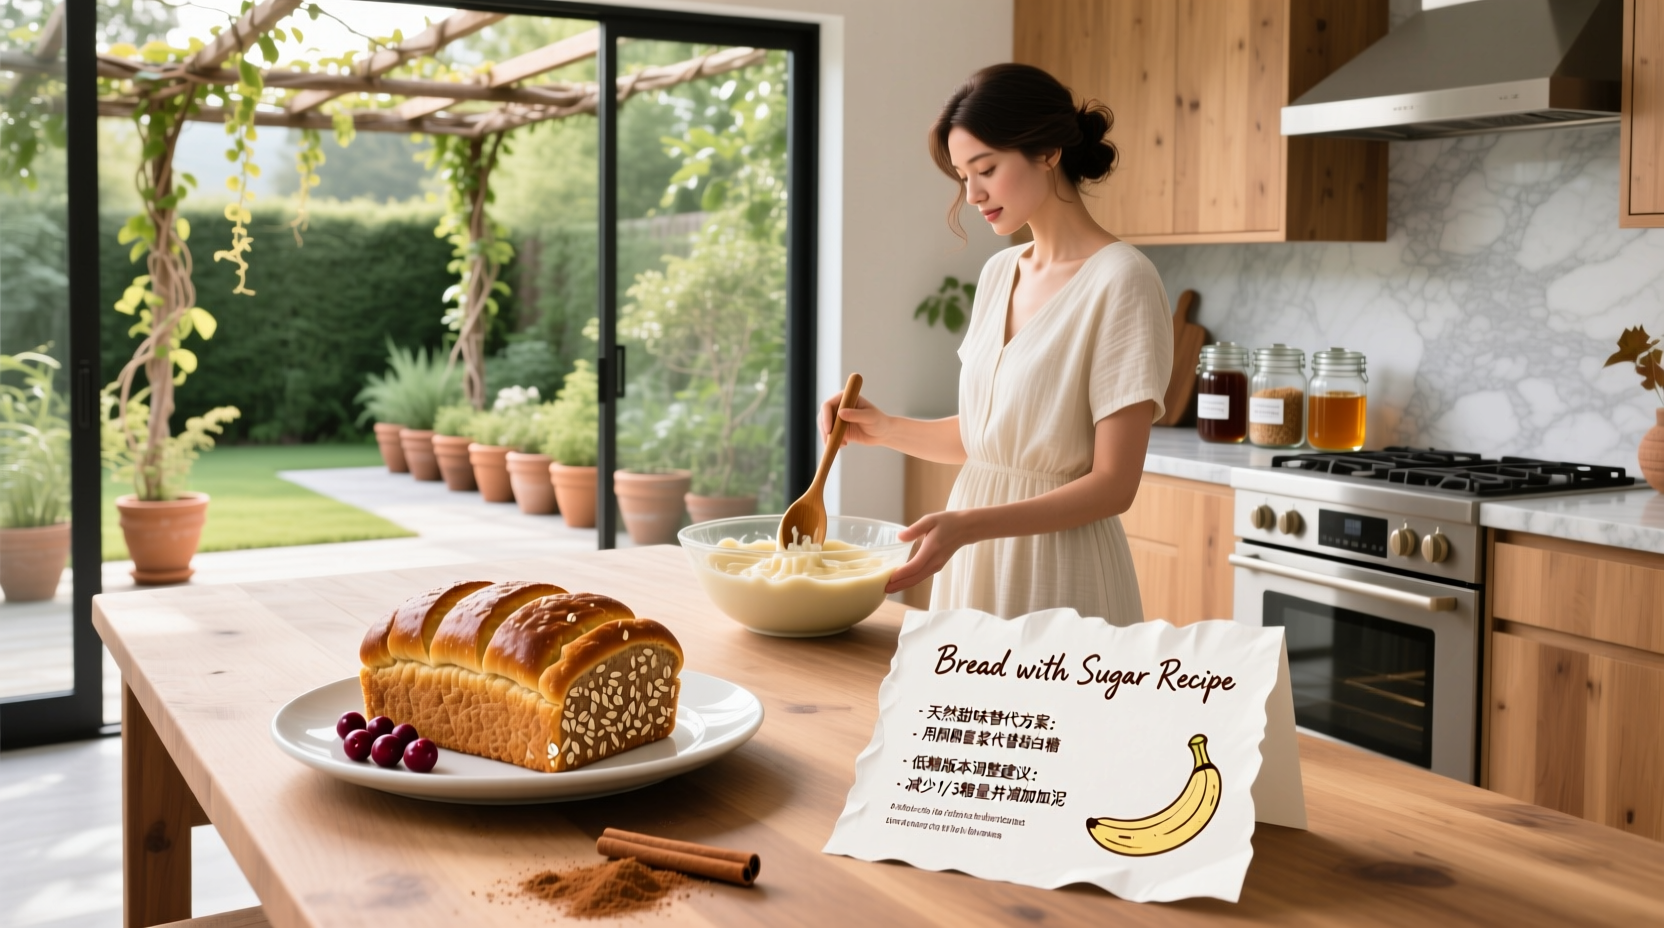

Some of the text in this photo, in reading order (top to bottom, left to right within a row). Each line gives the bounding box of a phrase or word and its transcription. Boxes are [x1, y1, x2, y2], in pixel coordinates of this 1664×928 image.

[934, 644, 1236, 704] Bread with Sugar Recipe
